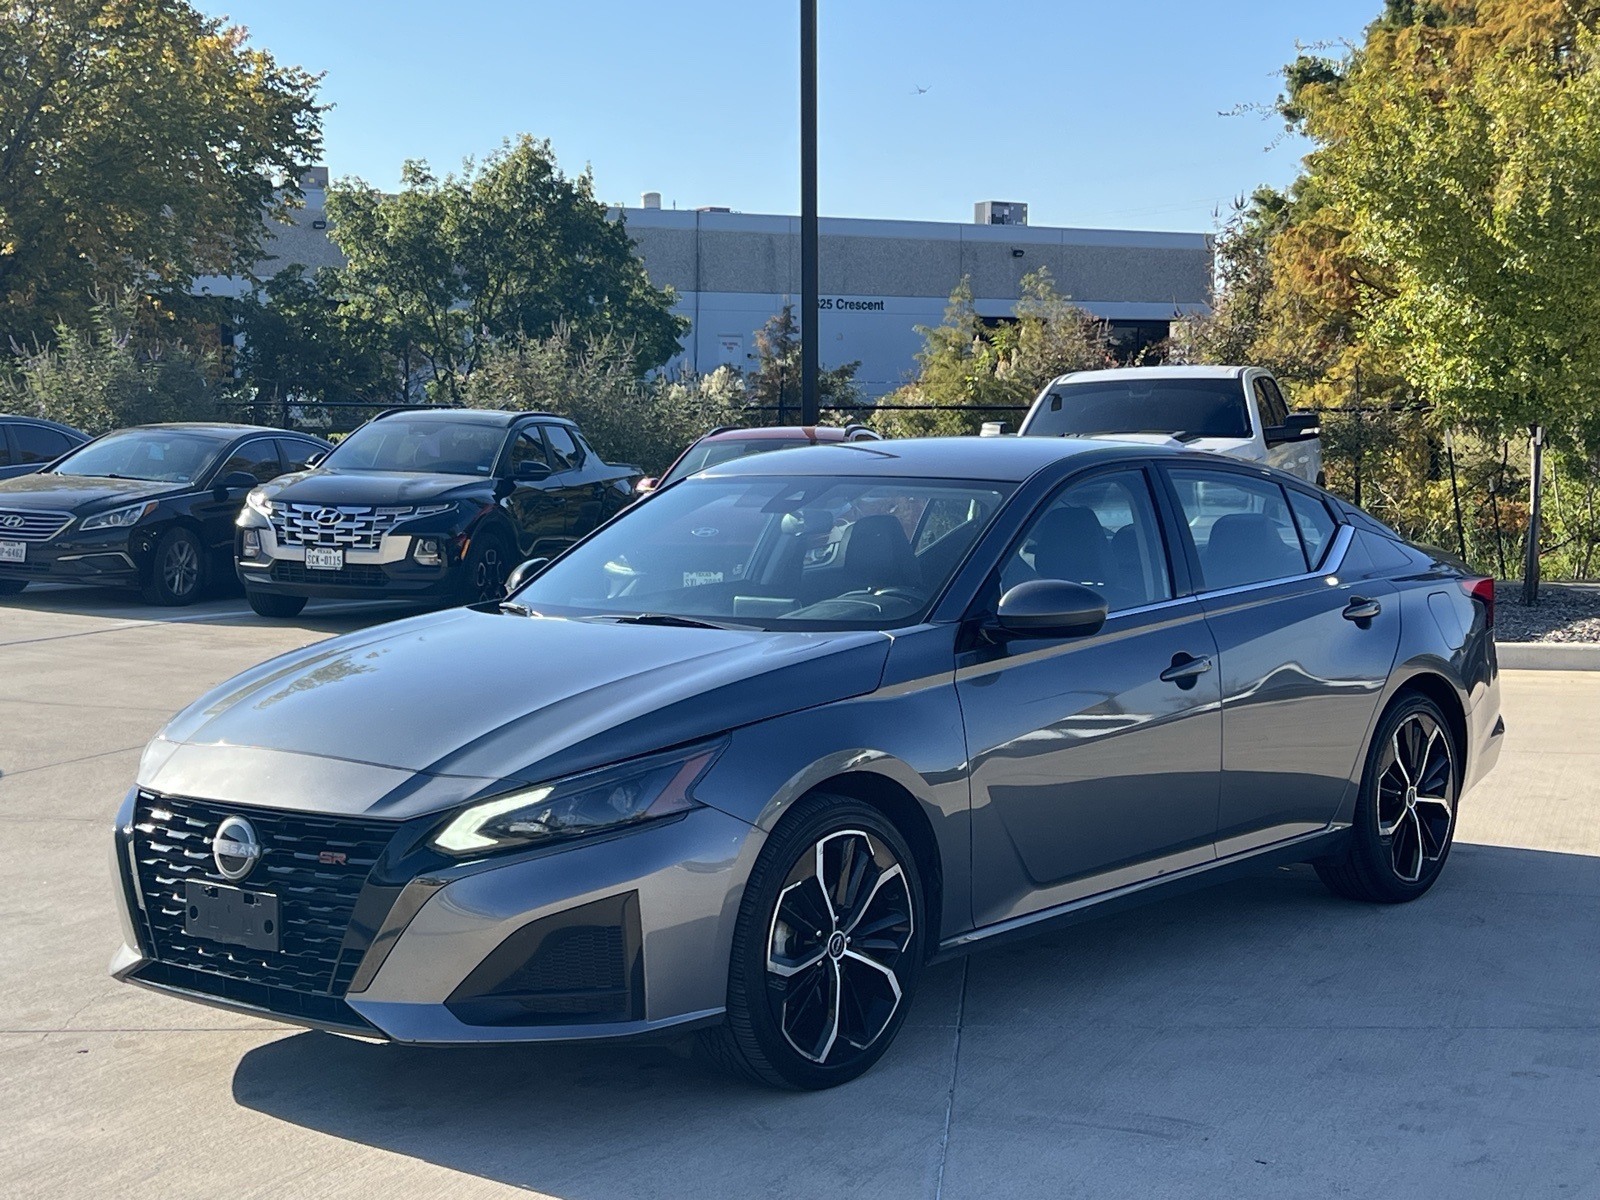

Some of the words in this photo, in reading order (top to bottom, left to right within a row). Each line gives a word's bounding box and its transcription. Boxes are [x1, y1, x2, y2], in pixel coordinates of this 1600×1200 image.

[817, 298, 833, 310] 25
[836, 298, 885, 311] Crescent
[307, 555, 342, 566] SCK-0115
[319, 851, 347, 866] SR
